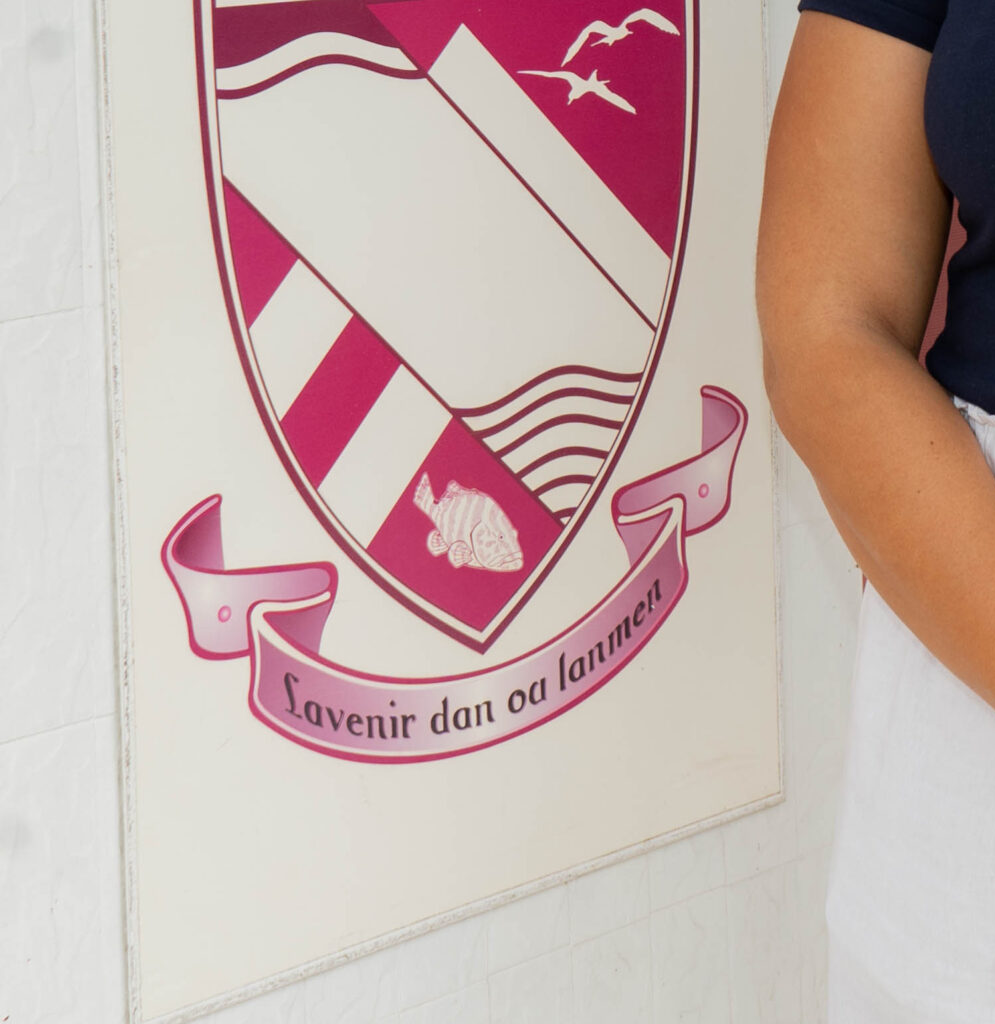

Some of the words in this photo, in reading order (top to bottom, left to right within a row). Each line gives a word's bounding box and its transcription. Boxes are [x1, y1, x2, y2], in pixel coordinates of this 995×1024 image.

[283, 672, 416, 739] Lavenir
[430, 695, 495, 735] dan
[558, 578, 664, 692] lanmen
